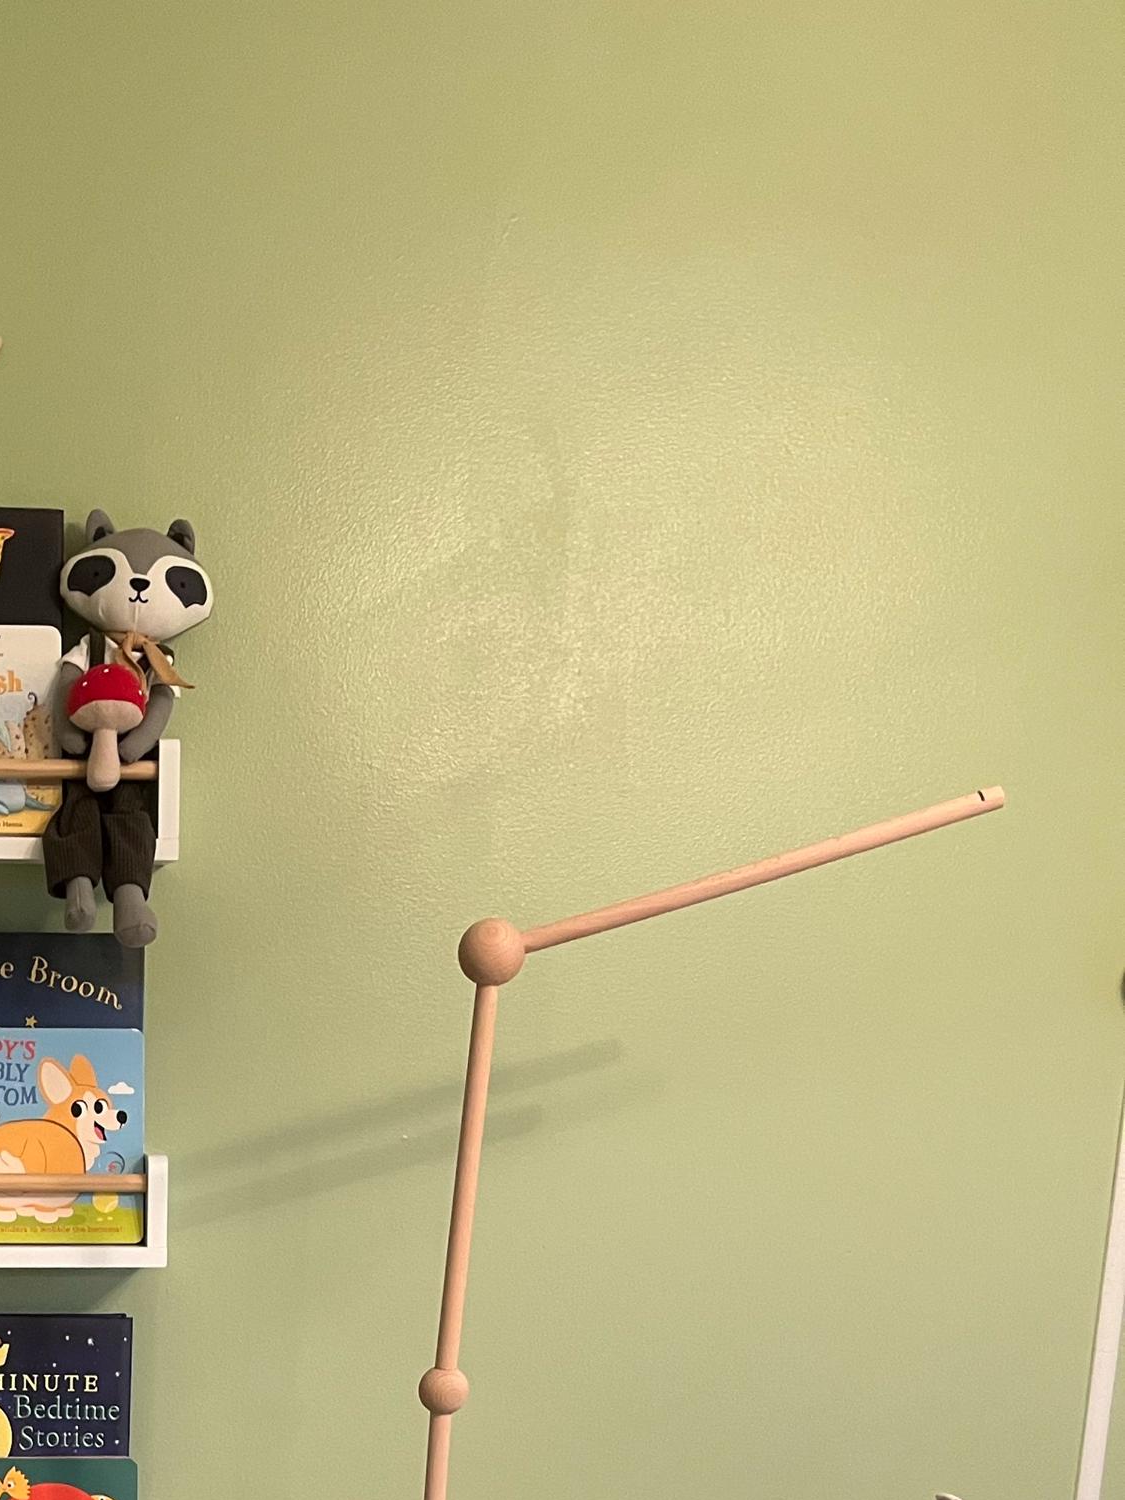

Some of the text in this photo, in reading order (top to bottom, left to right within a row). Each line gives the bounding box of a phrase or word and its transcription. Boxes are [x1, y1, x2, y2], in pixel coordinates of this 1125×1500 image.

[27, 955, 123, 1011] Broom
[13, 1394, 120, 1421] Bedtime
[19, 1425, 105, 1451] Stories
